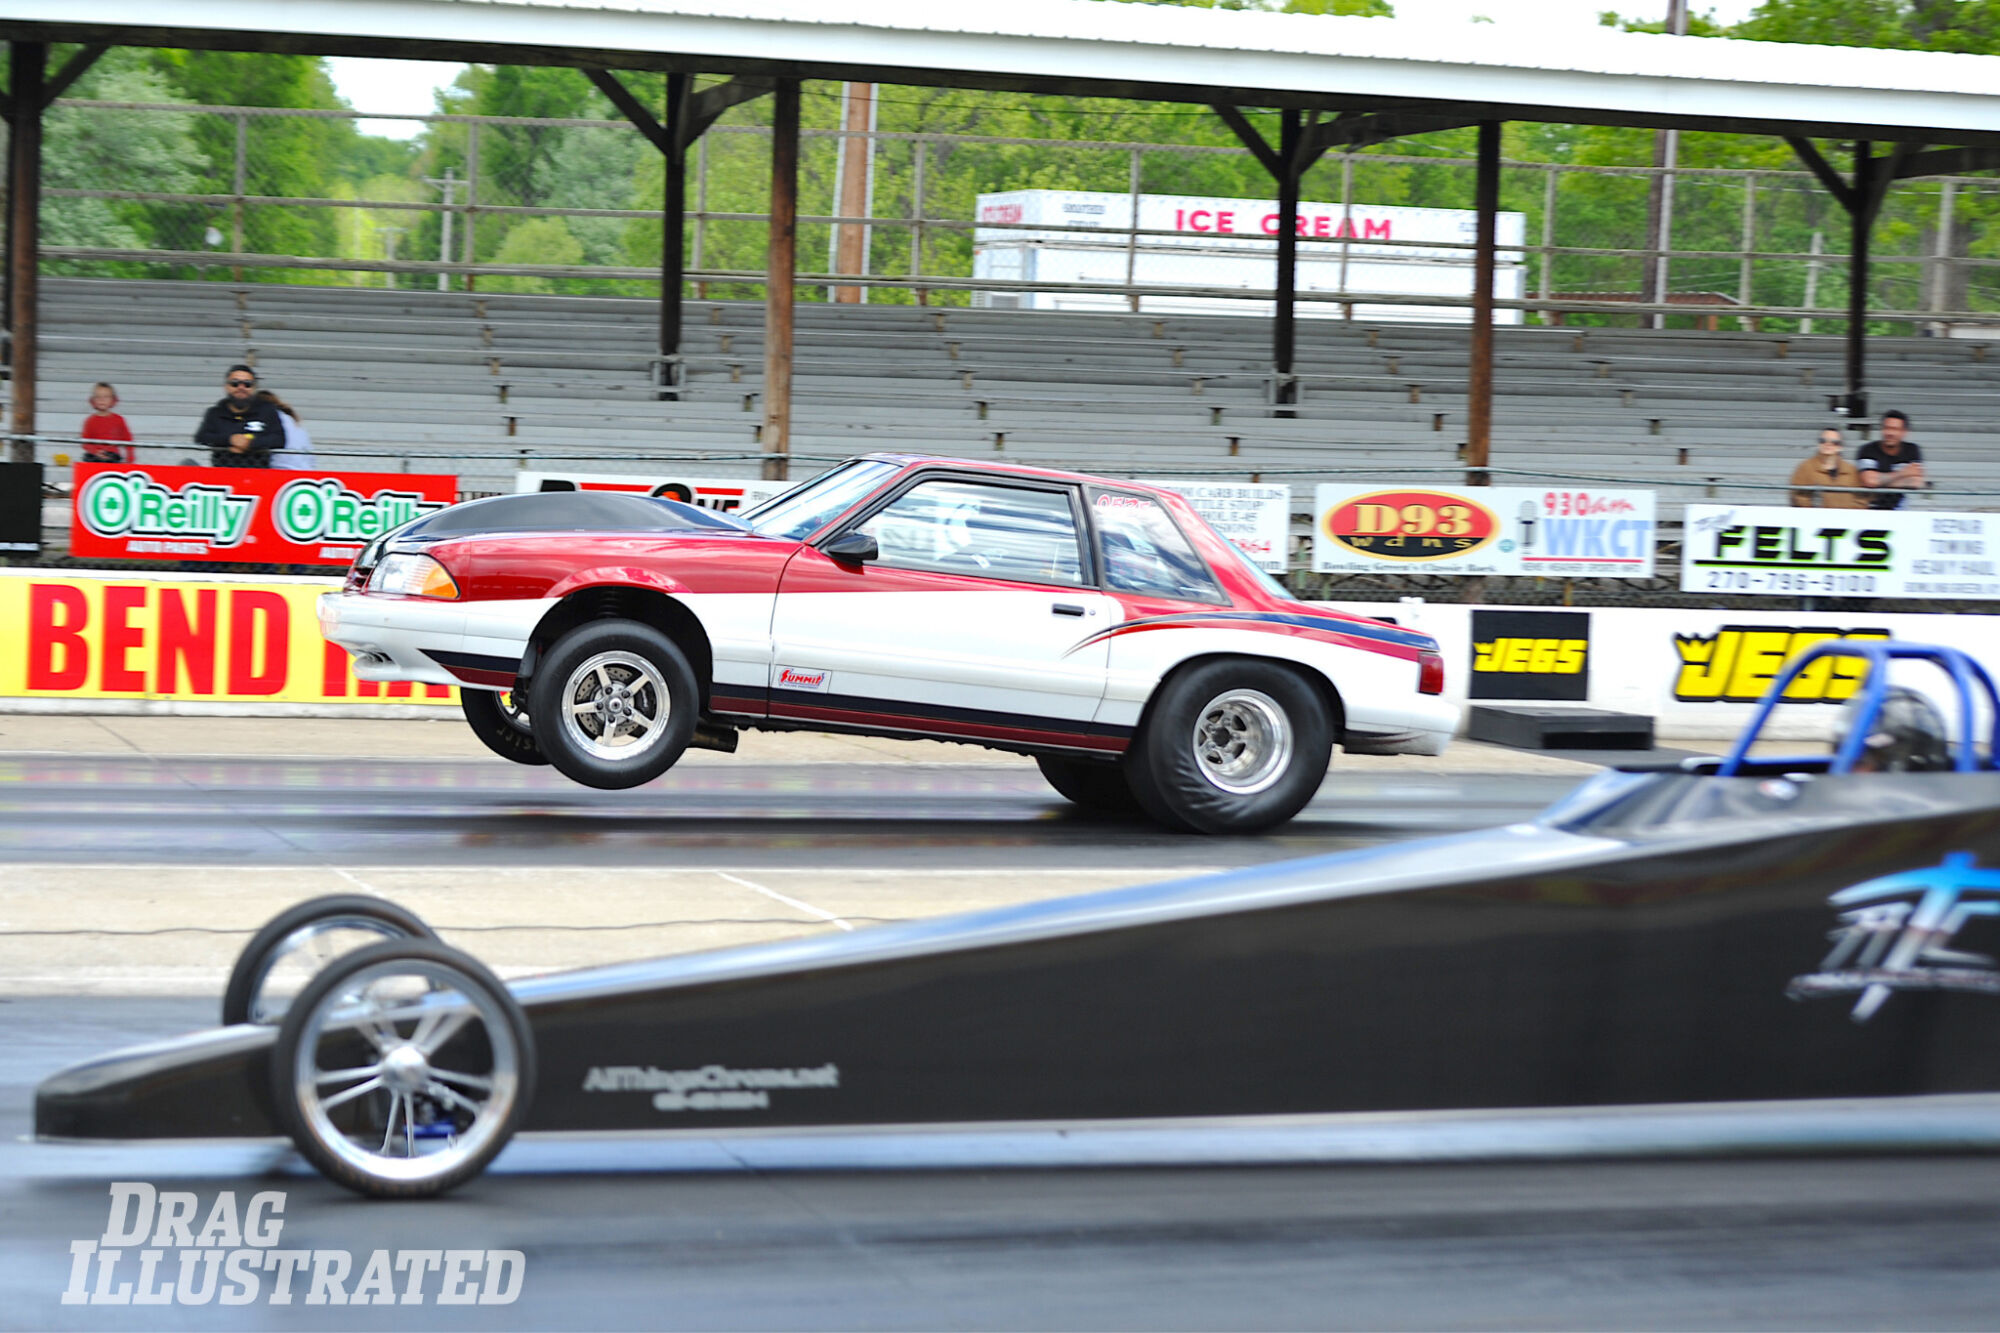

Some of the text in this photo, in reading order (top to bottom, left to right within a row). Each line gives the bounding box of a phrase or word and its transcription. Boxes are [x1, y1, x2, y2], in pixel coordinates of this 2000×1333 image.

[1175, 208, 1392, 241] ICE CREAM
[92, 481, 243, 538] O'Reilly
[285, 488, 420, 536] O'Reill
[1353, 504, 1473, 535] D93
[1543, 517, 1651, 559] WKCT
[27, 584, 289, 696] BEND
[1473, 638, 1588, 674] JEGS
[1675, 625, 1892, 703] JEGS
